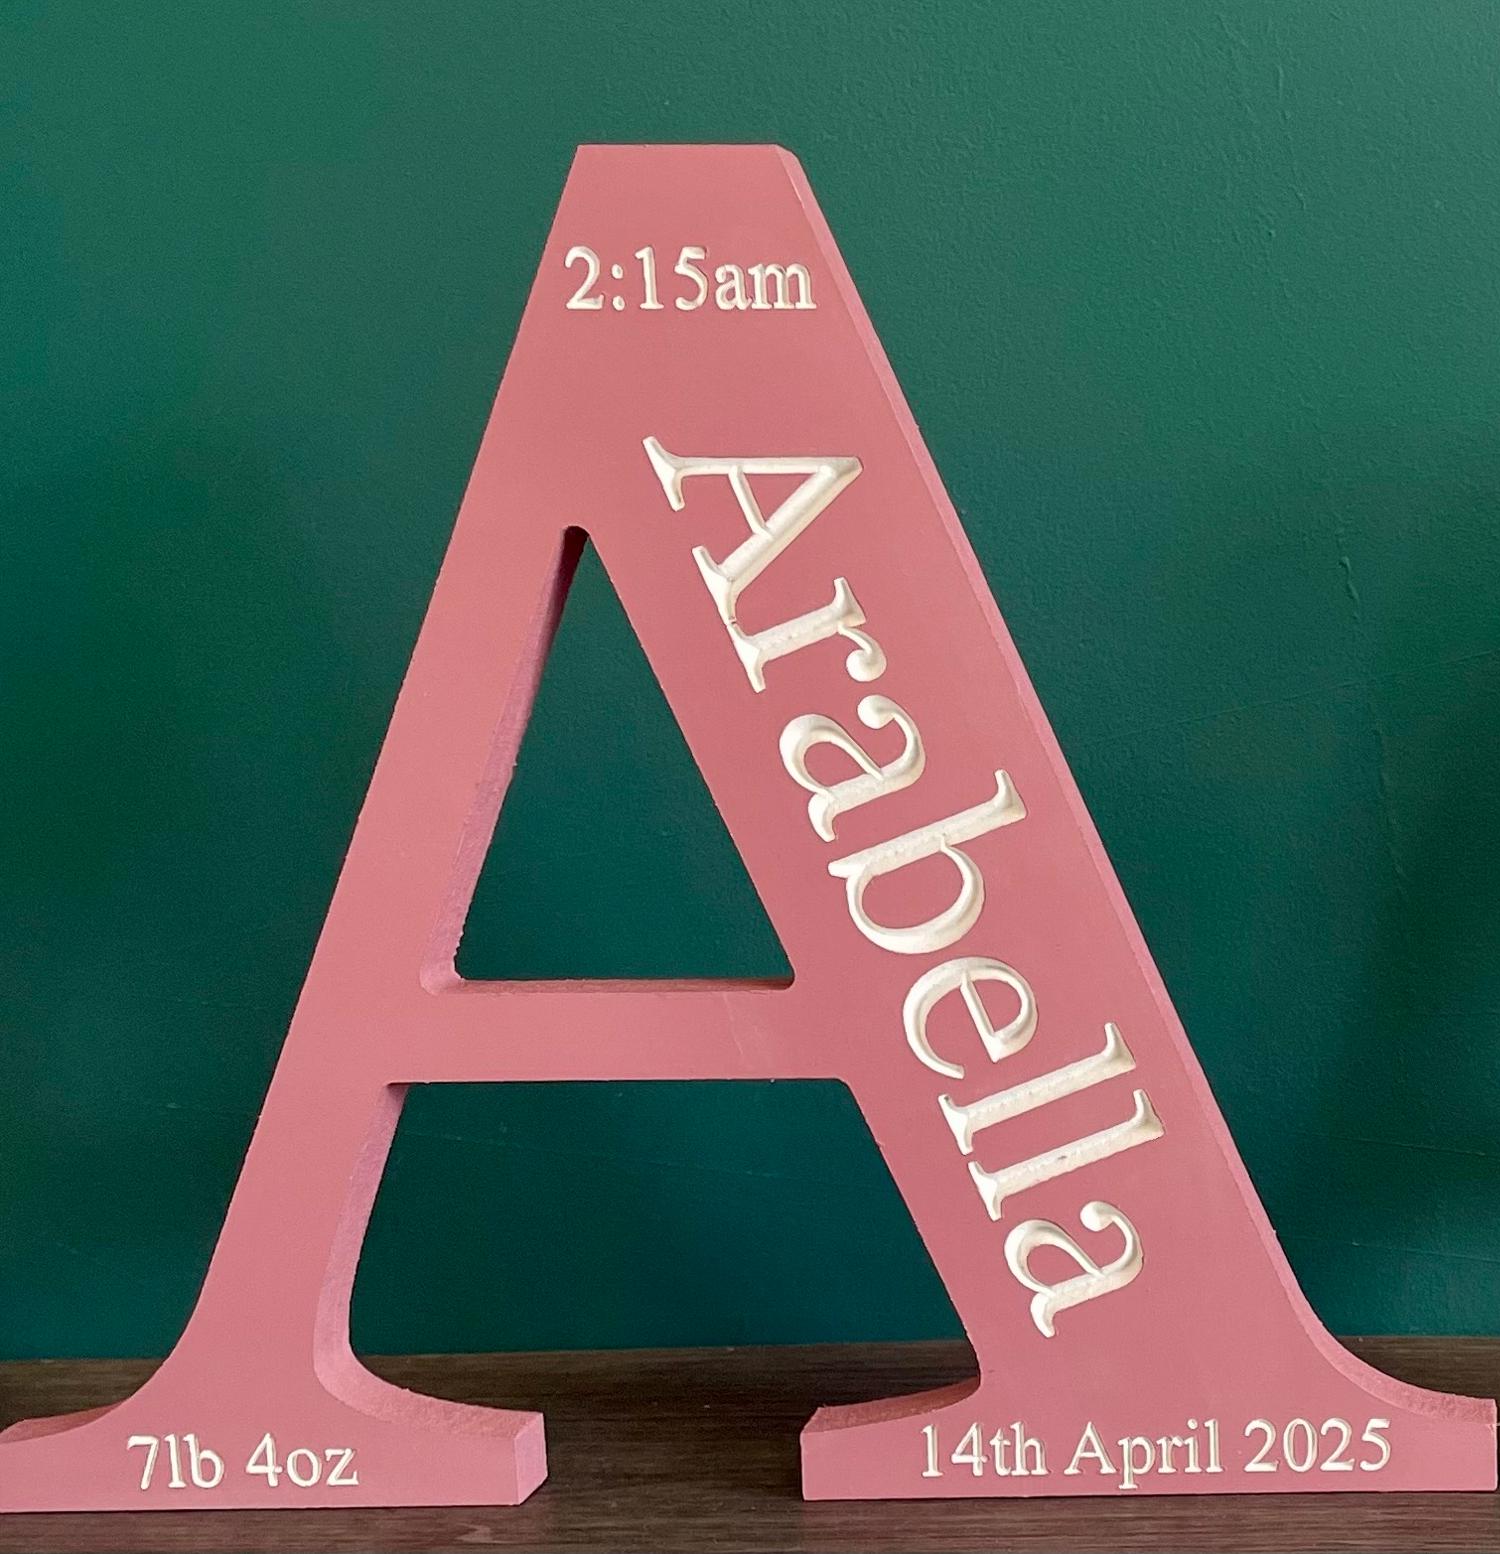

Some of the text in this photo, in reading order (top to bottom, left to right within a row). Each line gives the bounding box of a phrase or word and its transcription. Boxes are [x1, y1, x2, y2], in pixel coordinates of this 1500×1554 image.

[563, 243, 818, 313] 2:15am
[641, 434, 1166, 1340] Arabella
[126, 1431, 363, 1491] 7lb 4oz
[920, 1415, 1392, 1488] 14th April 2025
